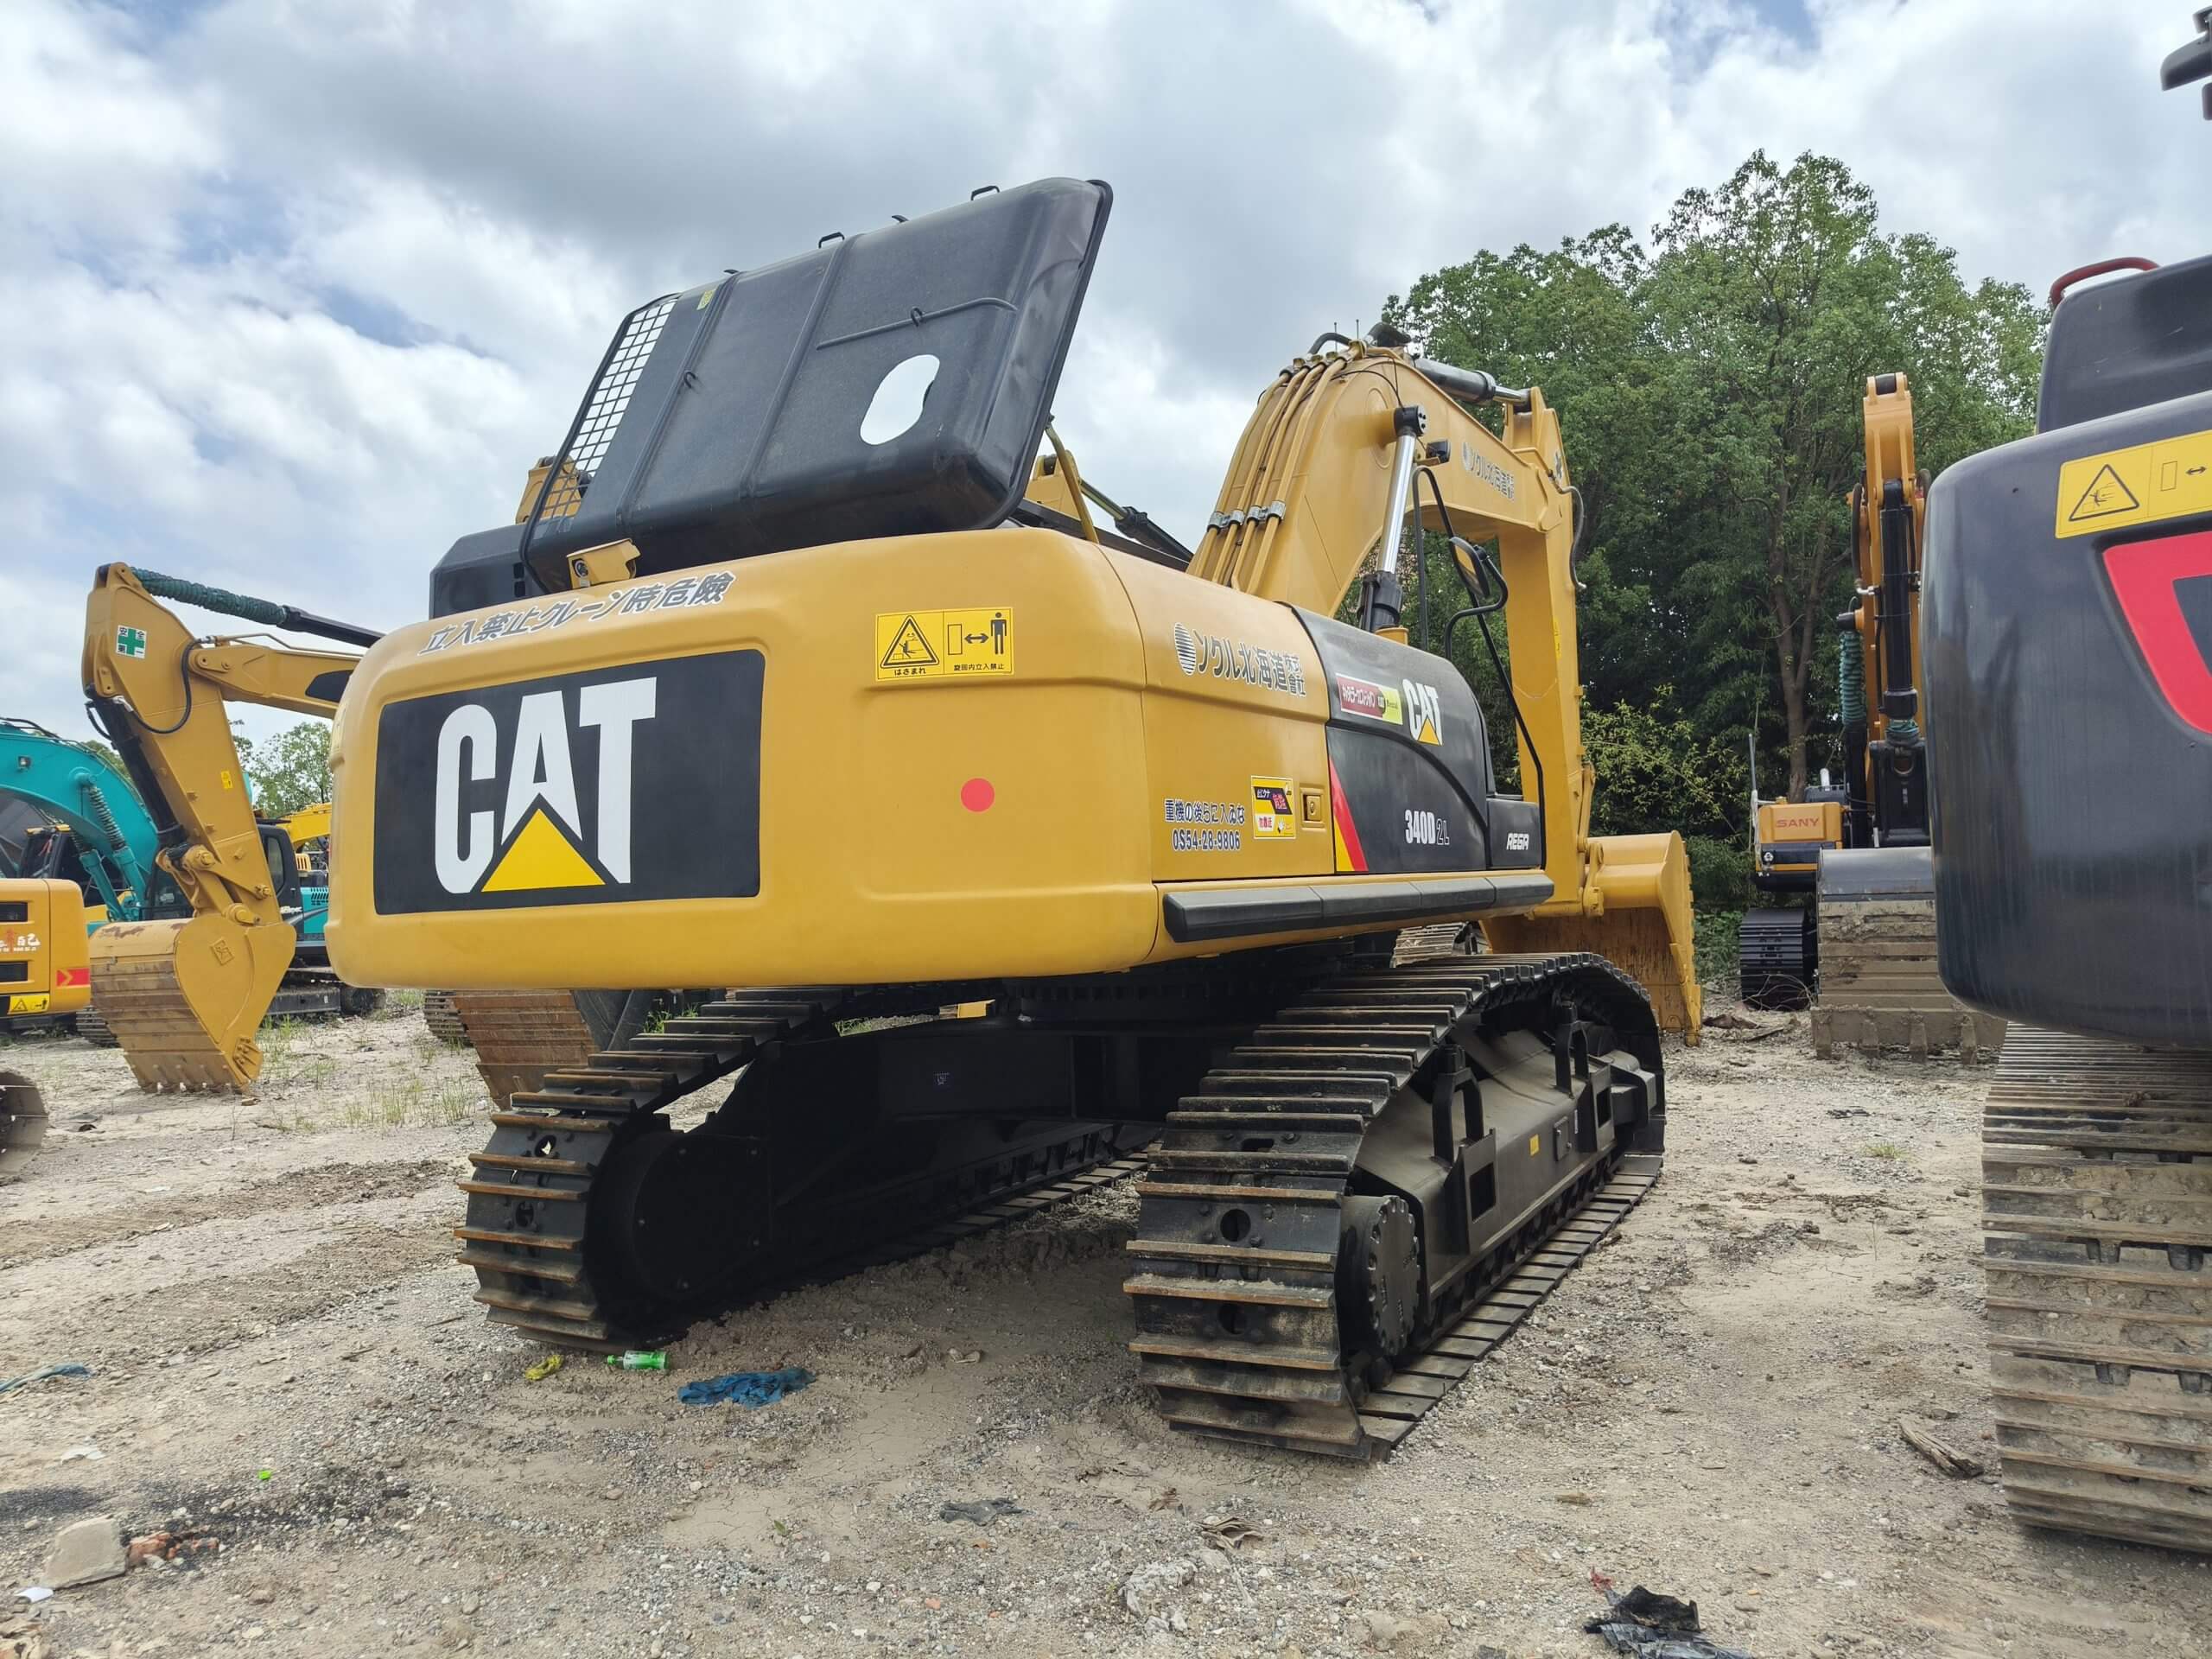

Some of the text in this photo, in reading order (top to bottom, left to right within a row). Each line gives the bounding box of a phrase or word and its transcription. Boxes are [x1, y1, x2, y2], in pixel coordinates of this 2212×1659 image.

[894, 668, 926, 677] はさまれ
[1402, 678, 1442, 746] CAT
[435, 677, 657, 894] CAT
[1777, 817, 1819, 828] SANY
